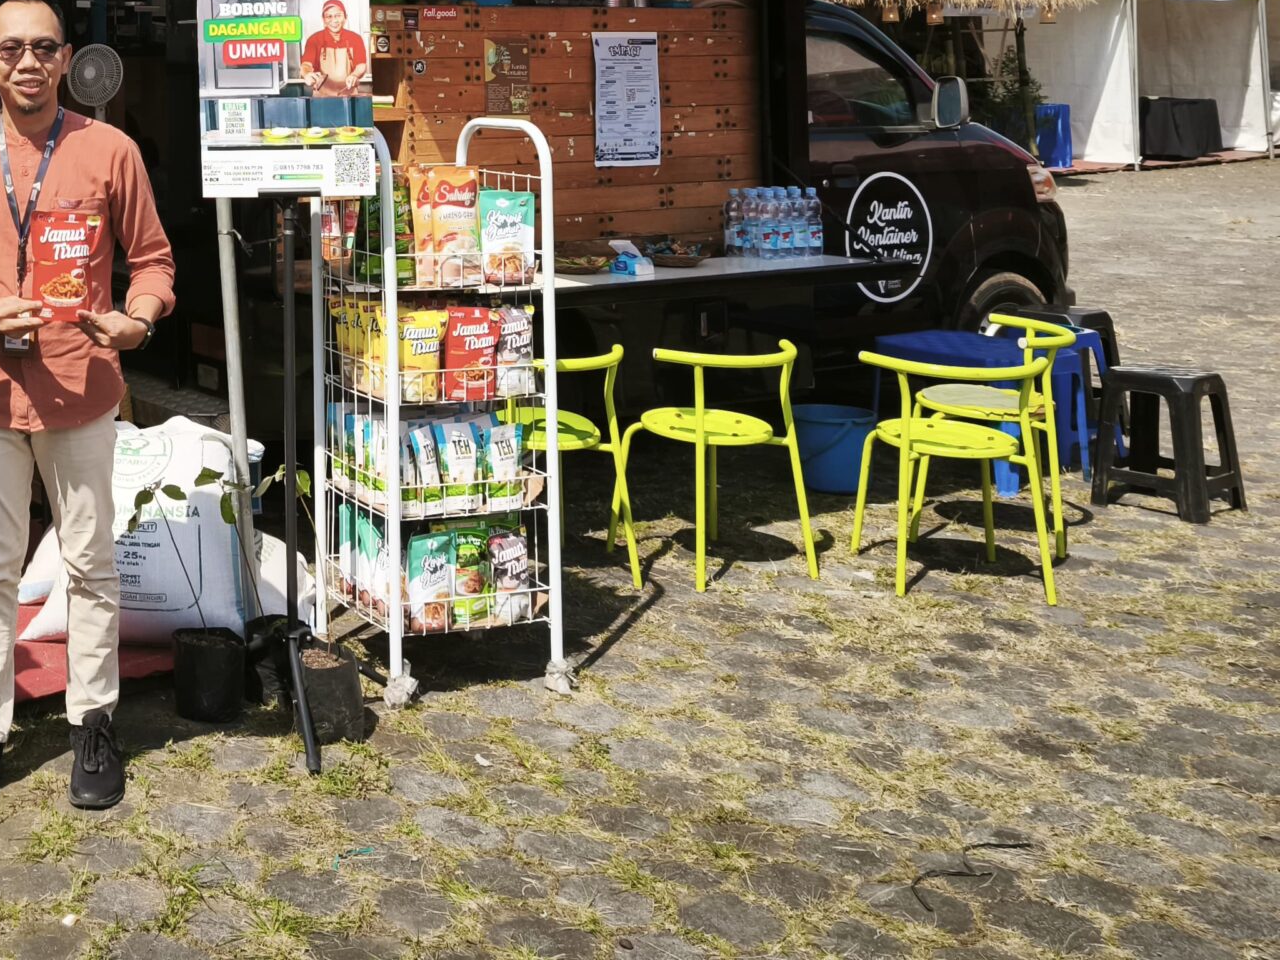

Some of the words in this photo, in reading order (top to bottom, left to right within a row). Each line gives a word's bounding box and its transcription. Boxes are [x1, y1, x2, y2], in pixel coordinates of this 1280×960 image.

[219, 1, 288, 16] BORONG
[423, 7, 457, 19] Fall.goods
[208, 21, 296, 37] DAGANGAN
[228, 42, 281, 59] UMKM
[866, 200, 913, 227] Kantin
[40, 226, 86, 244] Jamur
[53, 242, 90, 261] Tiram
[400, 324, 438, 340] Jamur
[452, 322, 490, 337] Jamur
[501, 318, 529, 335] amur
[464, 335, 495, 350] Tiram
[451, 438, 472, 456] TEH
[494, 438, 515, 457] TEH
[492, 541, 527, 564] Jamur
